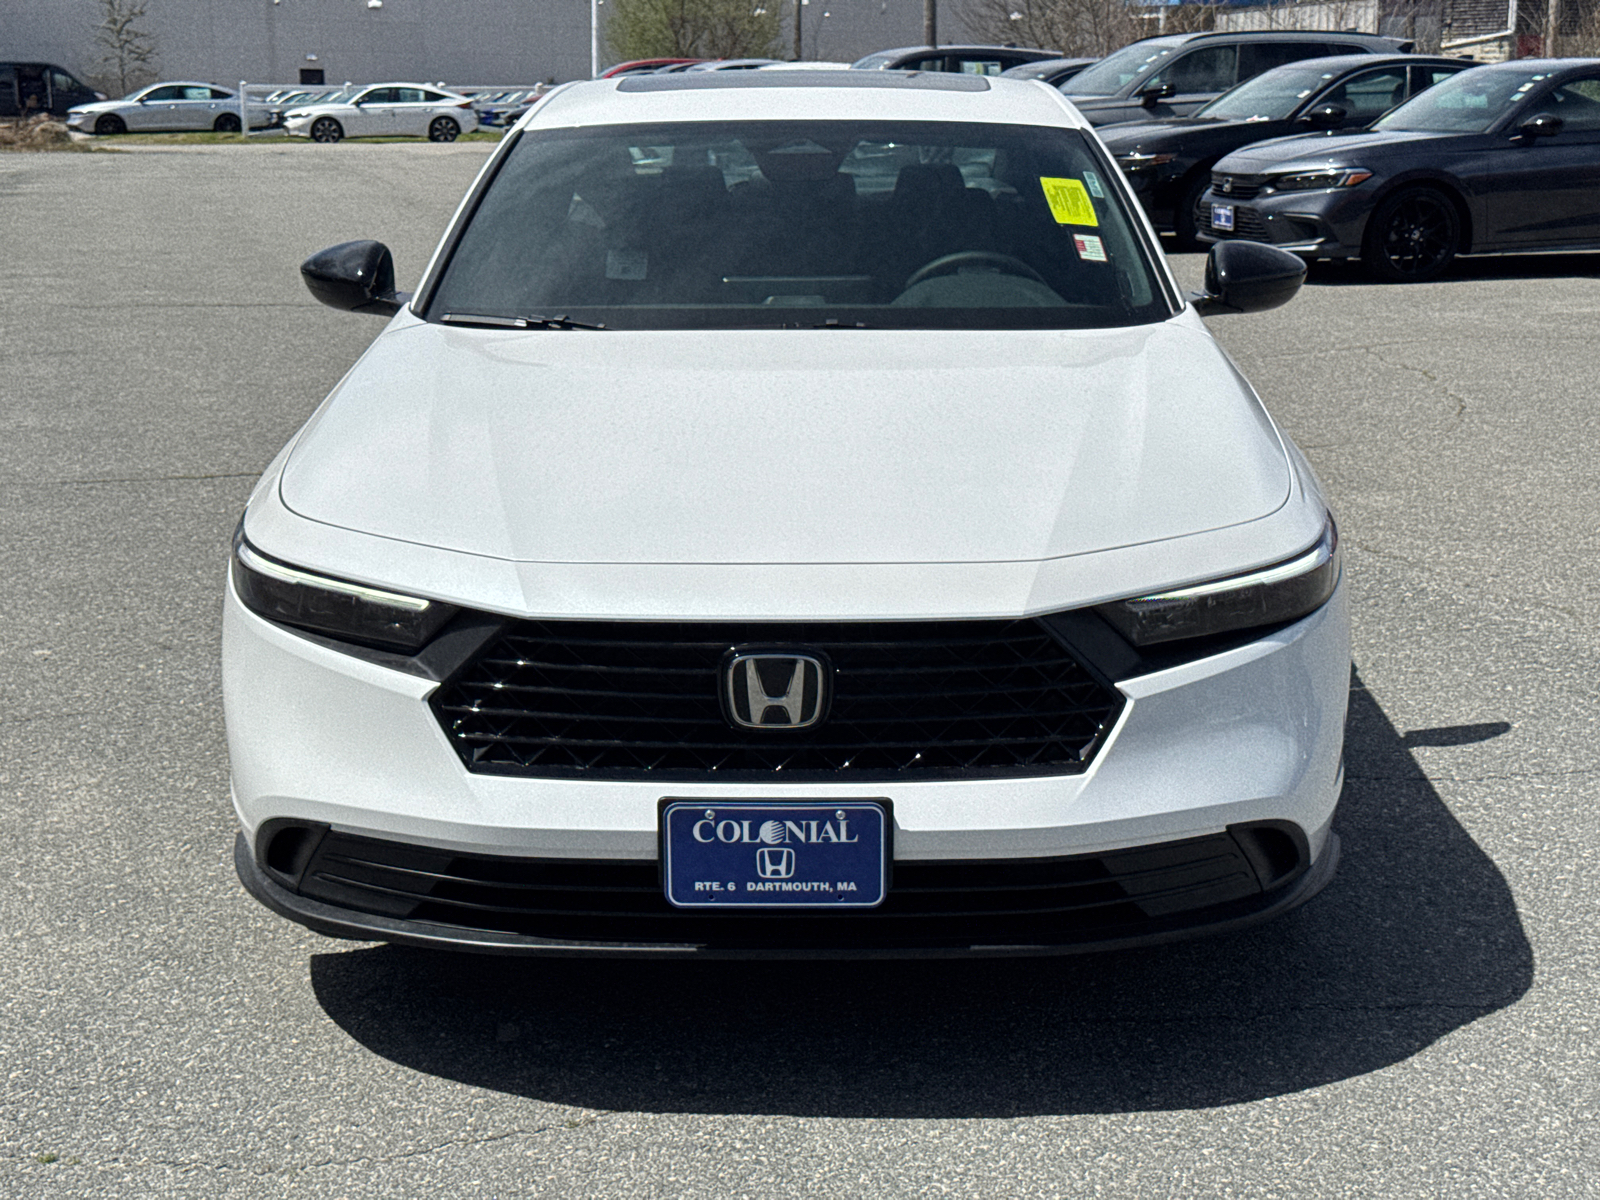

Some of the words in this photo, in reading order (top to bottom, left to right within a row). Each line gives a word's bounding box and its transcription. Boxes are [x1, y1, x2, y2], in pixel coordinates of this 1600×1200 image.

[692, 819, 859, 845] COLONIAL
[694, 881, 725, 892] RTE.
[727, 881, 737, 892] 6
[746, 881, 834, 893] DARTMOUTH,
[836, 881, 858, 892] MA
